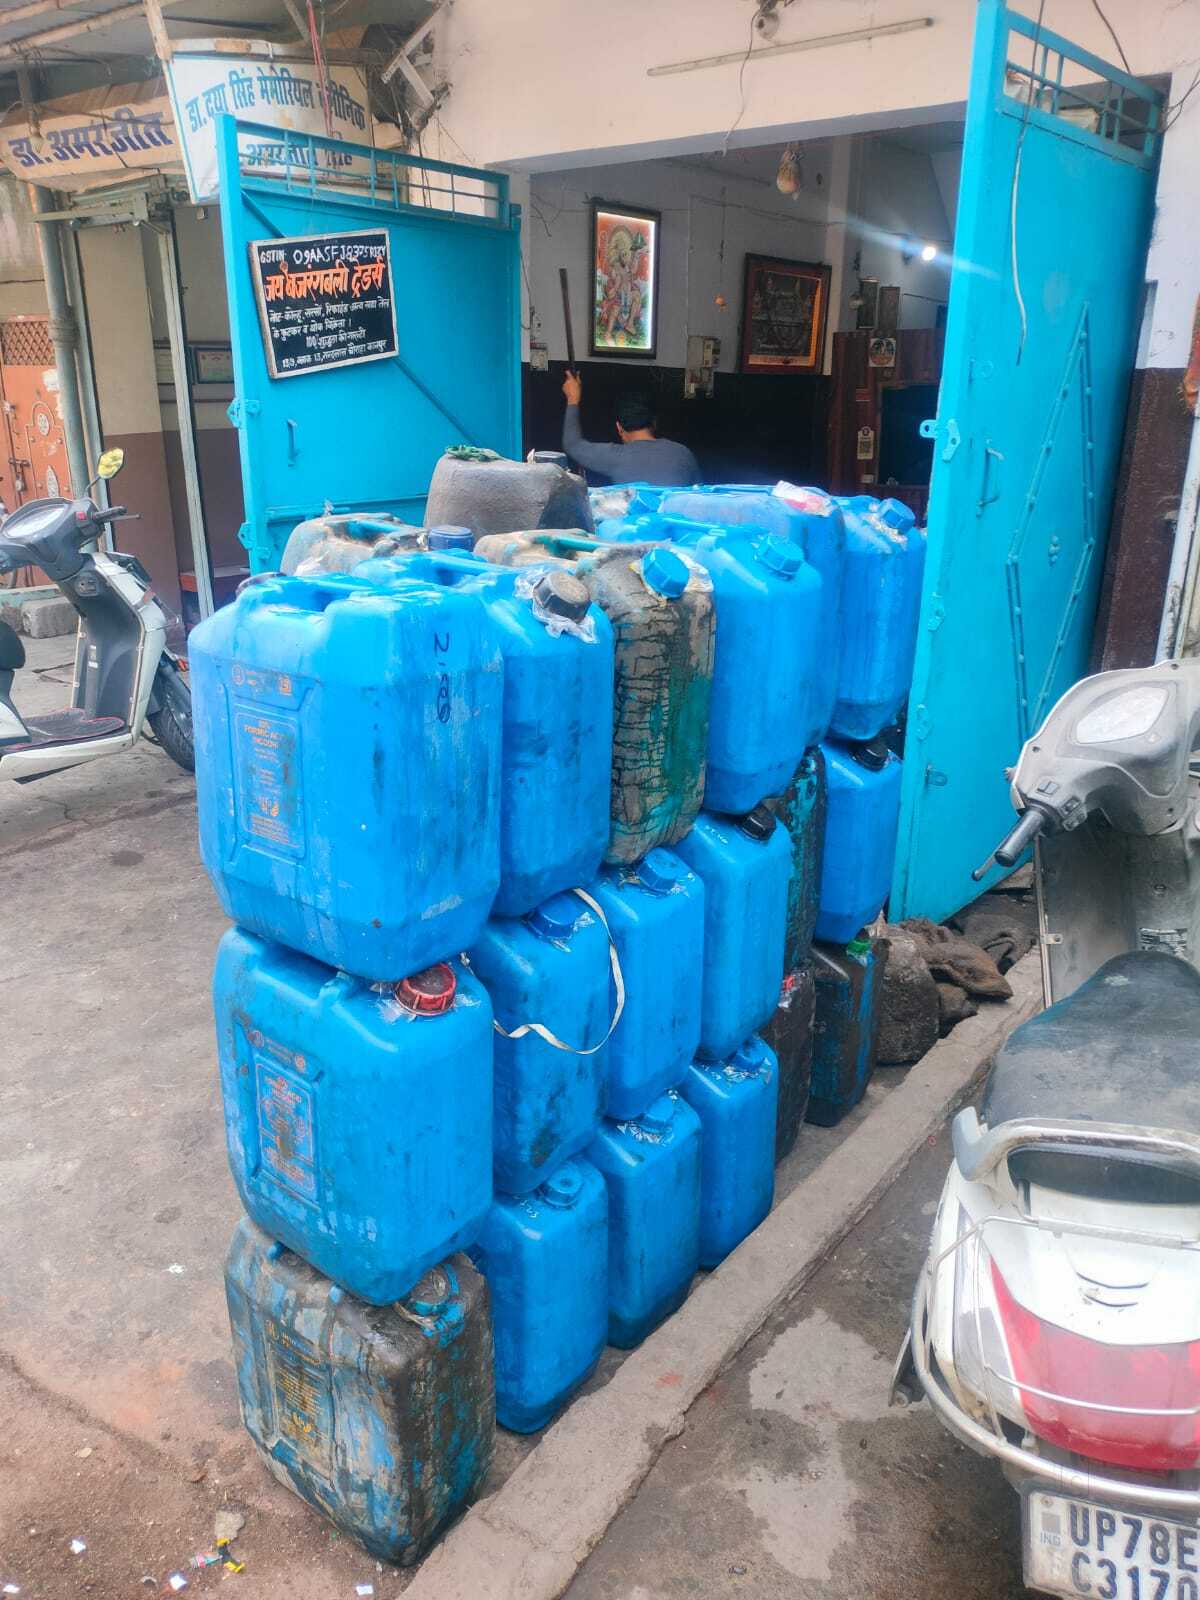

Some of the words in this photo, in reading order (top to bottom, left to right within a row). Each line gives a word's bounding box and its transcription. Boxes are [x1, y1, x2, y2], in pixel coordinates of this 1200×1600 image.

[229, 68, 256, 110] सिंह
[257, 65, 315, 109] मेमोरियल
[264, 274, 284, 302] जय
[1070, 1503, 1198, 1573] UP78E
